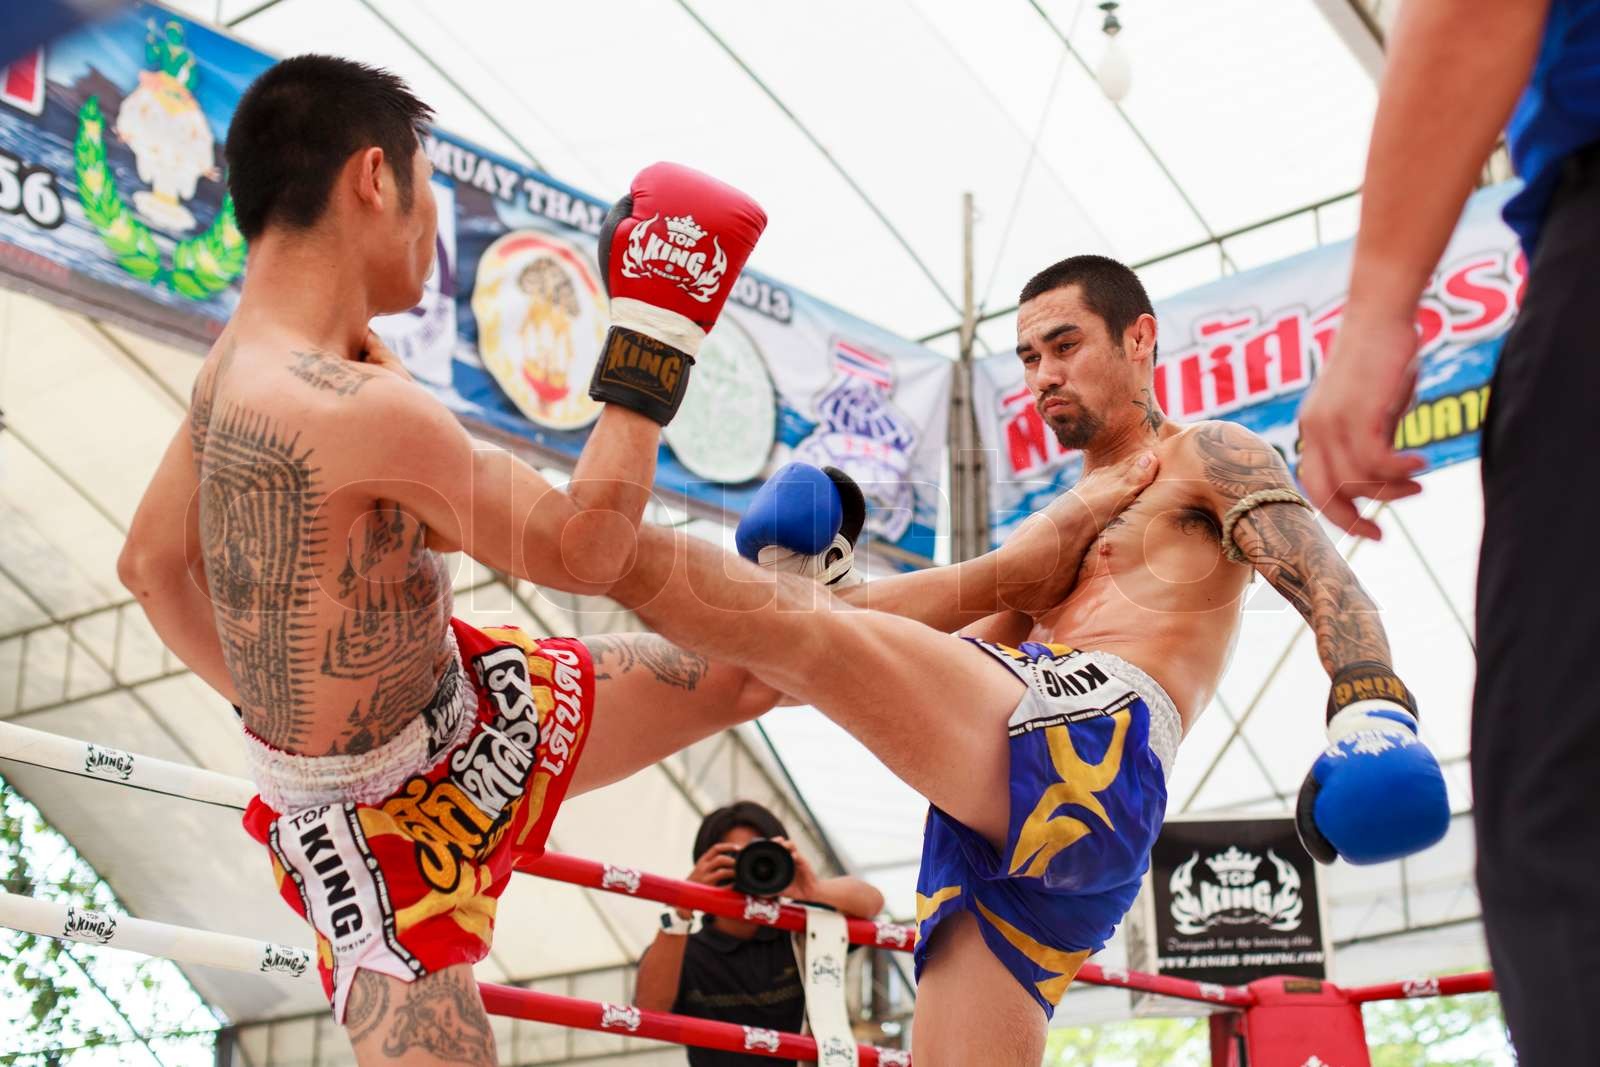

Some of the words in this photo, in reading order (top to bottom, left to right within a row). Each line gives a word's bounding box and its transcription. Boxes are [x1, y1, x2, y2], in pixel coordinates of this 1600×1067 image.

[426, 136, 517, 200] MUAY
[642, 232, 707, 280] KING
[667, 231, 697, 249] TOP
[732, 276, 790, 319] 013
[607, 335, 681, 393] KING
[1042, 662, 1109, 698] KING
[96, 752, 124, 771] KING
[288, 805, 331, 831] TOP
[299, 823, 363, 938] KING
[1216, 871, 1256, 887] TOP
[1200, 880, 1272, 920] KING
[76, 917, 105, 936] KING
[272, 953, 299, 970] KING
